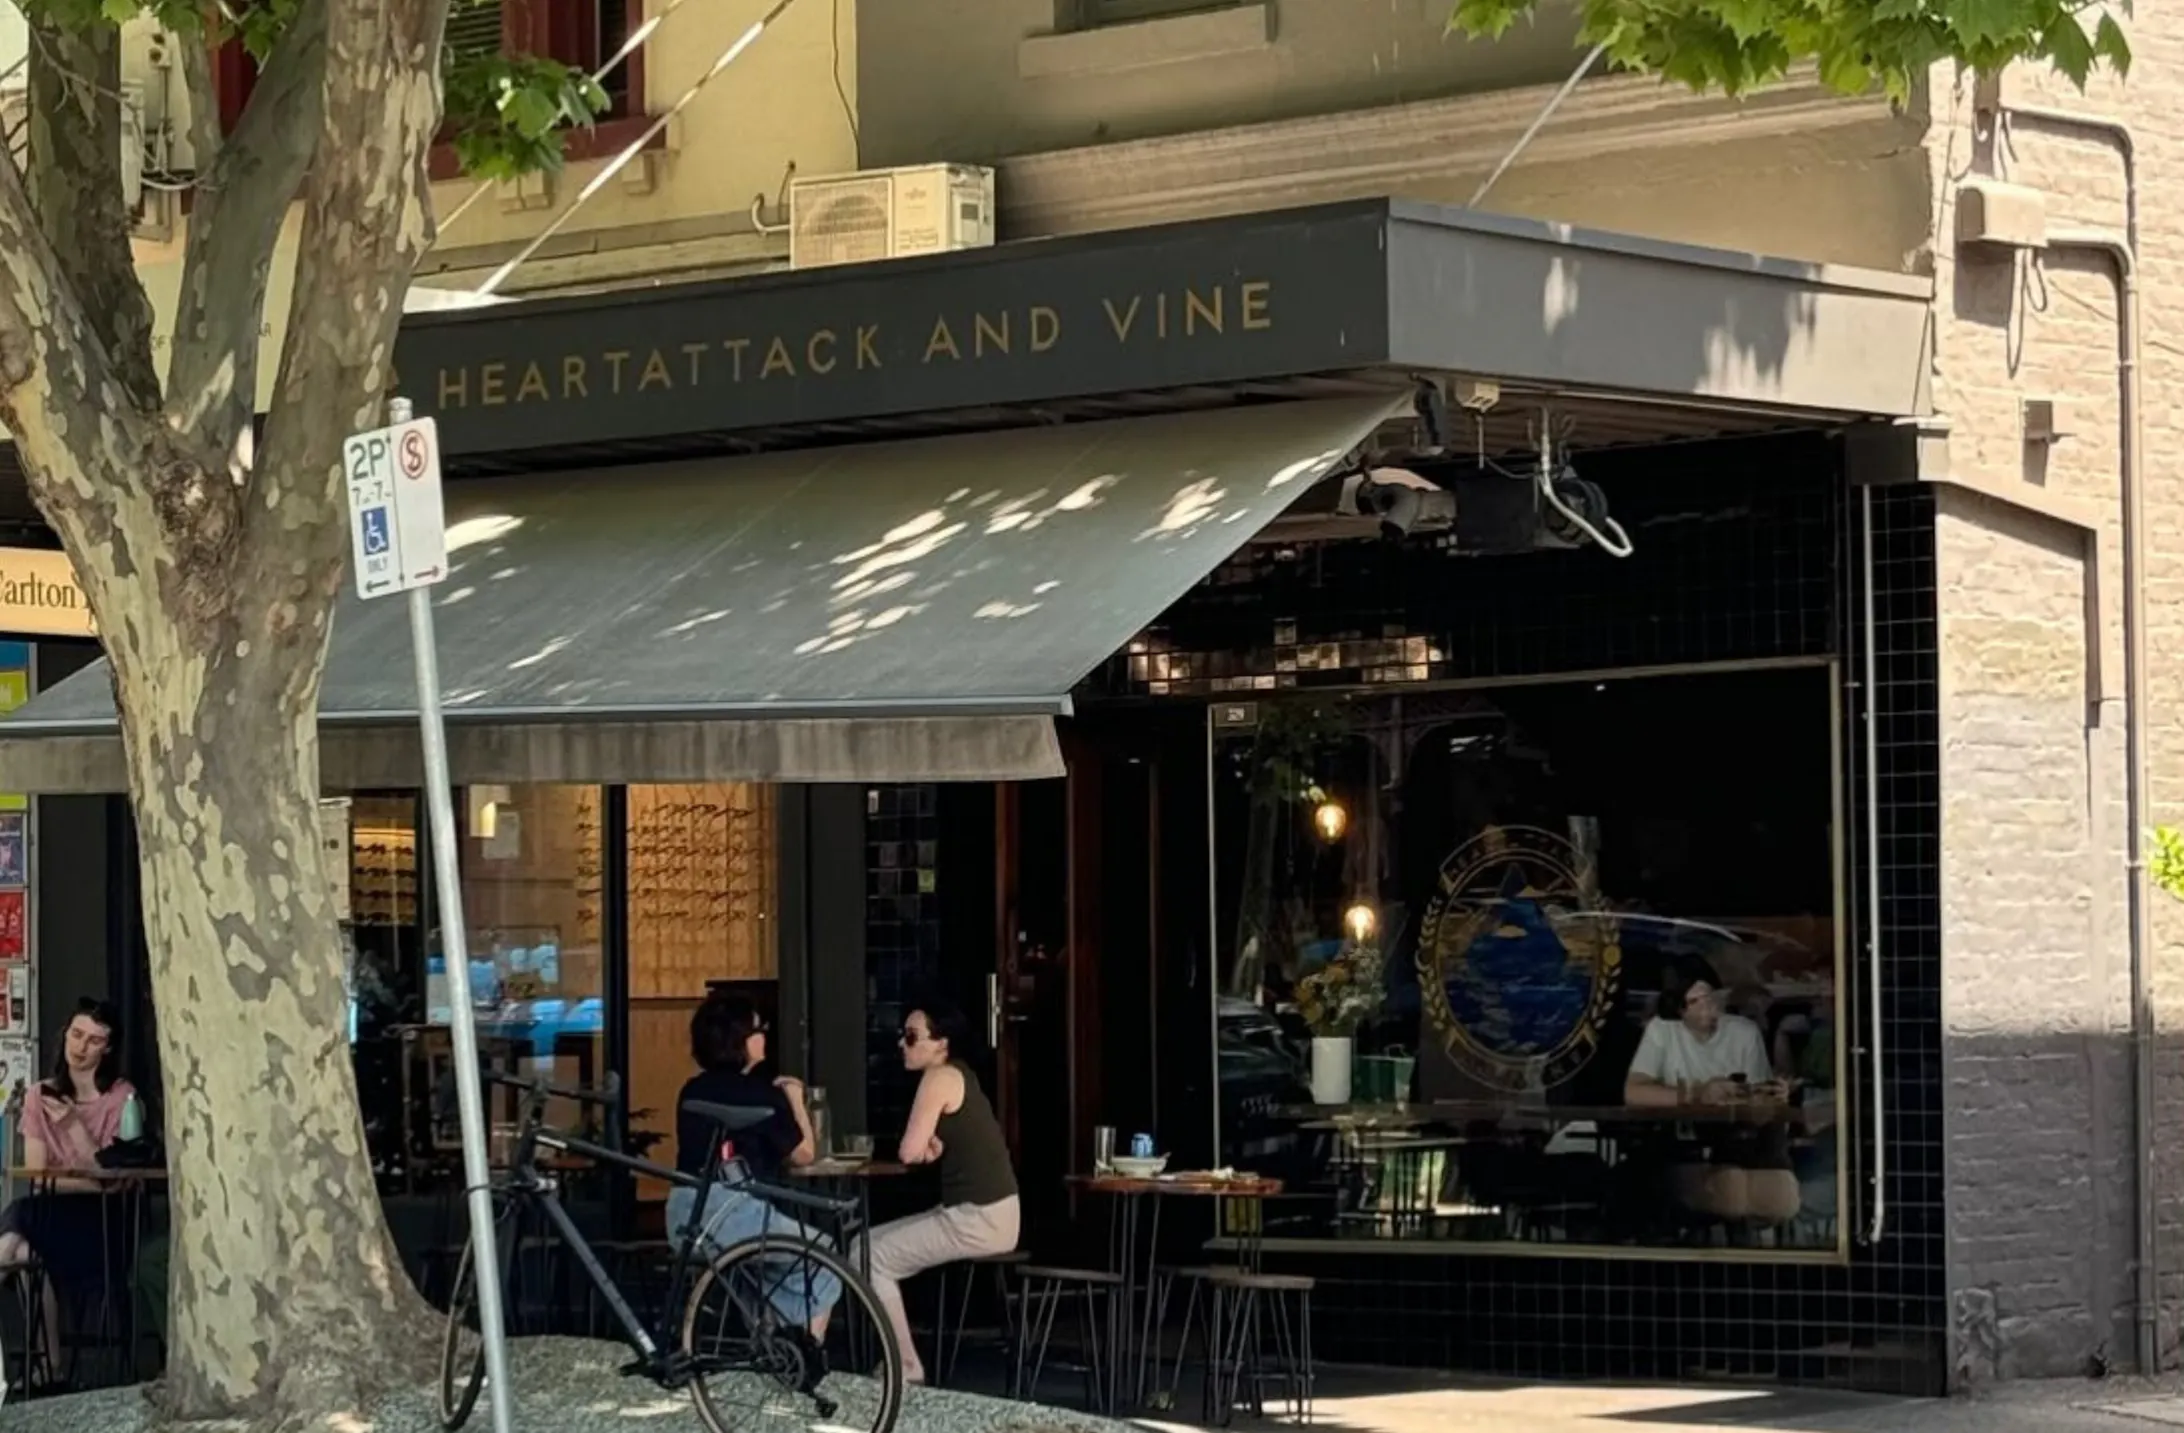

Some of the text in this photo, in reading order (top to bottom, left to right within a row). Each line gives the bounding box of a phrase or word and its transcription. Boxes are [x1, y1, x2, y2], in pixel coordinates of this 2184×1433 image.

[438, 281, 1271, 410] HEARTATTACK AND VINE
[350, 438, 386, 481] 2P
[0, 570, 76, 608] arlton
